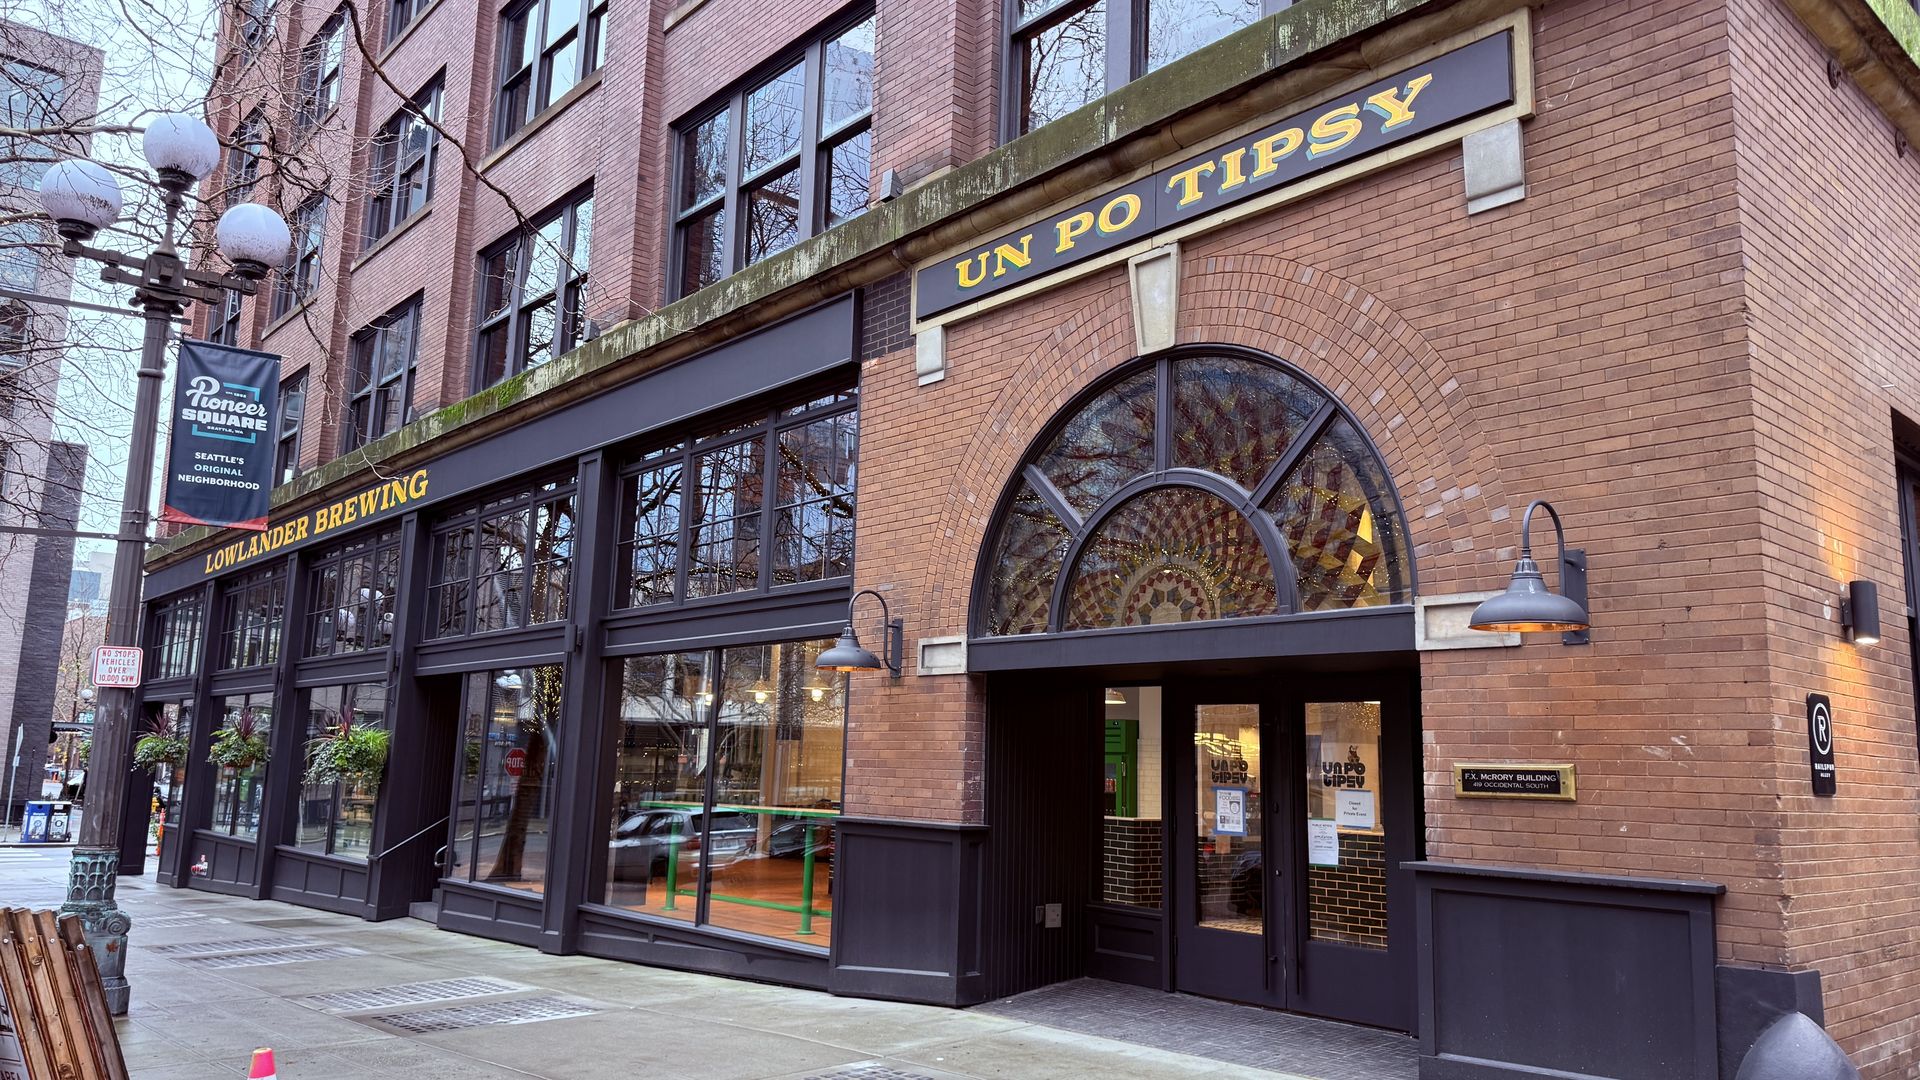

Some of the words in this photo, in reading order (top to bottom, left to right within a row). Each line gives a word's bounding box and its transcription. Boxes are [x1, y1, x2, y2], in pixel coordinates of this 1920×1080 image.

[955, 234, 1032, 289] UN
[1055, 193, 1142, 256] PO
[1166, 73, 1433, 211] TIPSY
[185, 375, 268, 417] Pioneer
[181, 408, 268, 431] SQUARE
[194, 451, 245, 465] SEATTLE'S
[194, 463, 244, 477] ORIGINAL
[177, 473, 260, 490] NEIGHBORHOOD
[204, 515, 309, 575] LOWLANDER
[314, 469, 429, 534] BREWING
[114, 650, 137, 658] STOPS
[101, 658, 136, 666] VEHICLES
[1480, 773, 1514, 781] McRORY
[1516, 774, 1557, 782] BUILDING
